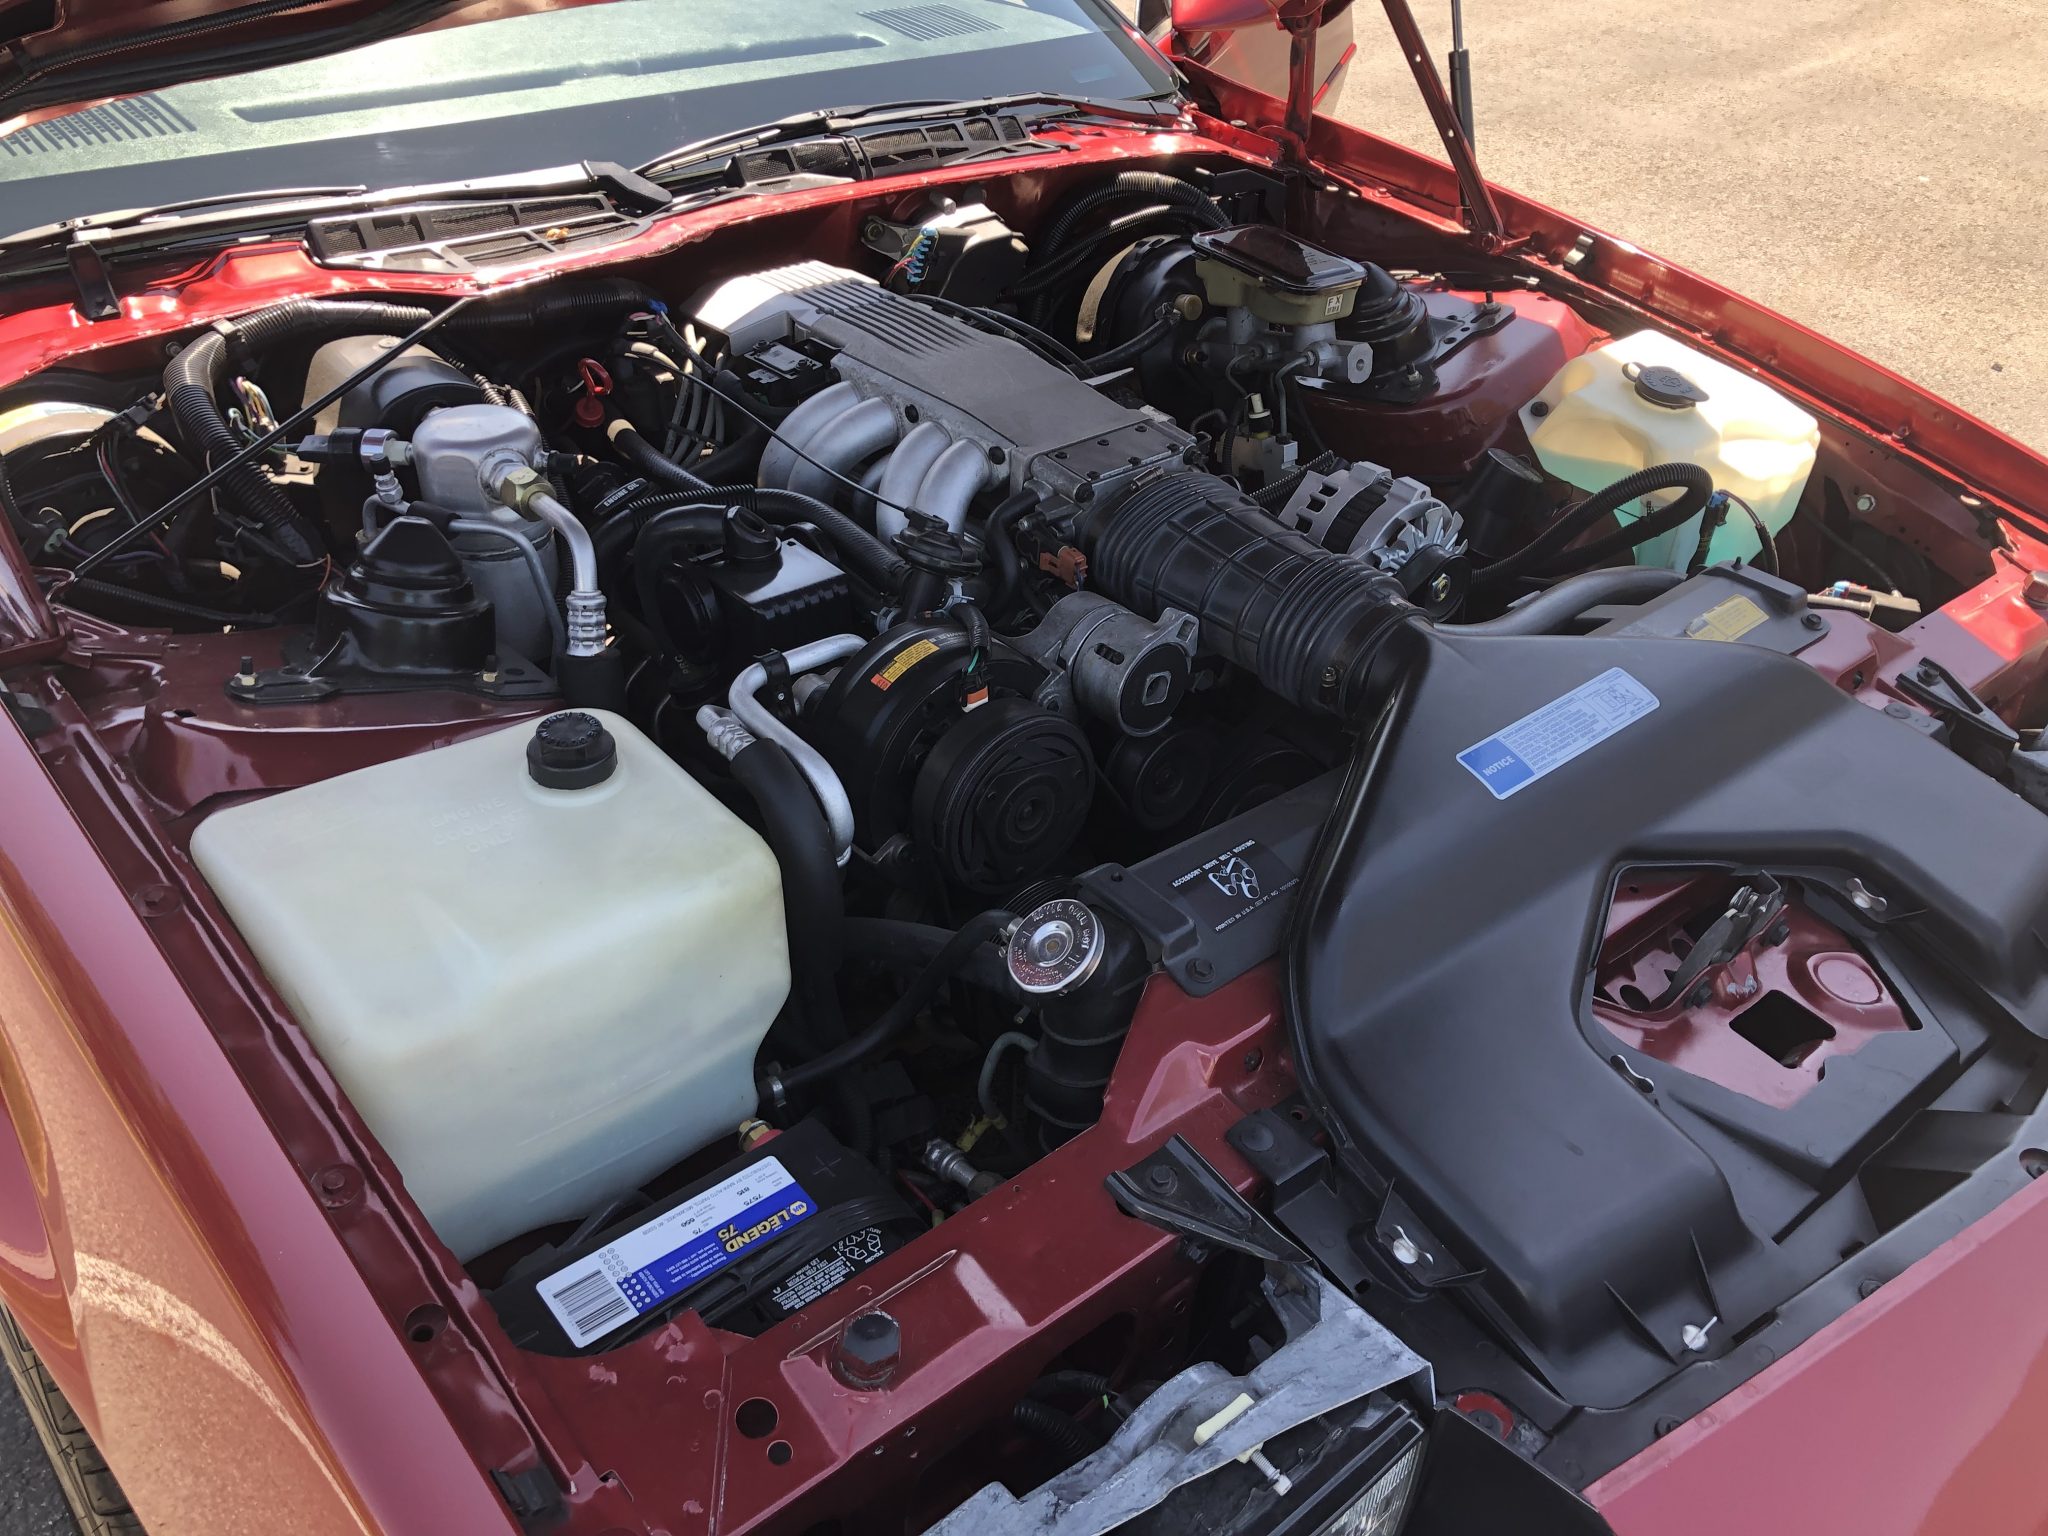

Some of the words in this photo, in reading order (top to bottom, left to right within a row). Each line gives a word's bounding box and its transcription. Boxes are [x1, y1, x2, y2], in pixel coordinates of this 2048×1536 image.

[603, 489, 629, 507] ENGINE
[627, 482, 640, 491] OIL
[1482, 755, 1515, 777] NOTICE
[1172, 868, 1202, 887] ACCESSORY
[1202, 858, 1219, 870] DRIVE
[1218, 850, 1232, 861] BELT
[1232, 839, 1255, 853] ROUTING
[1215, 916, 1235, 931] PRINTED
[742, 1193, 763, 1206] 7575
[691, 1227, 702, 1235] 75
[716, 1223, 739, 1241] 75
[722, 1209, 792, 1253] LEGEND
